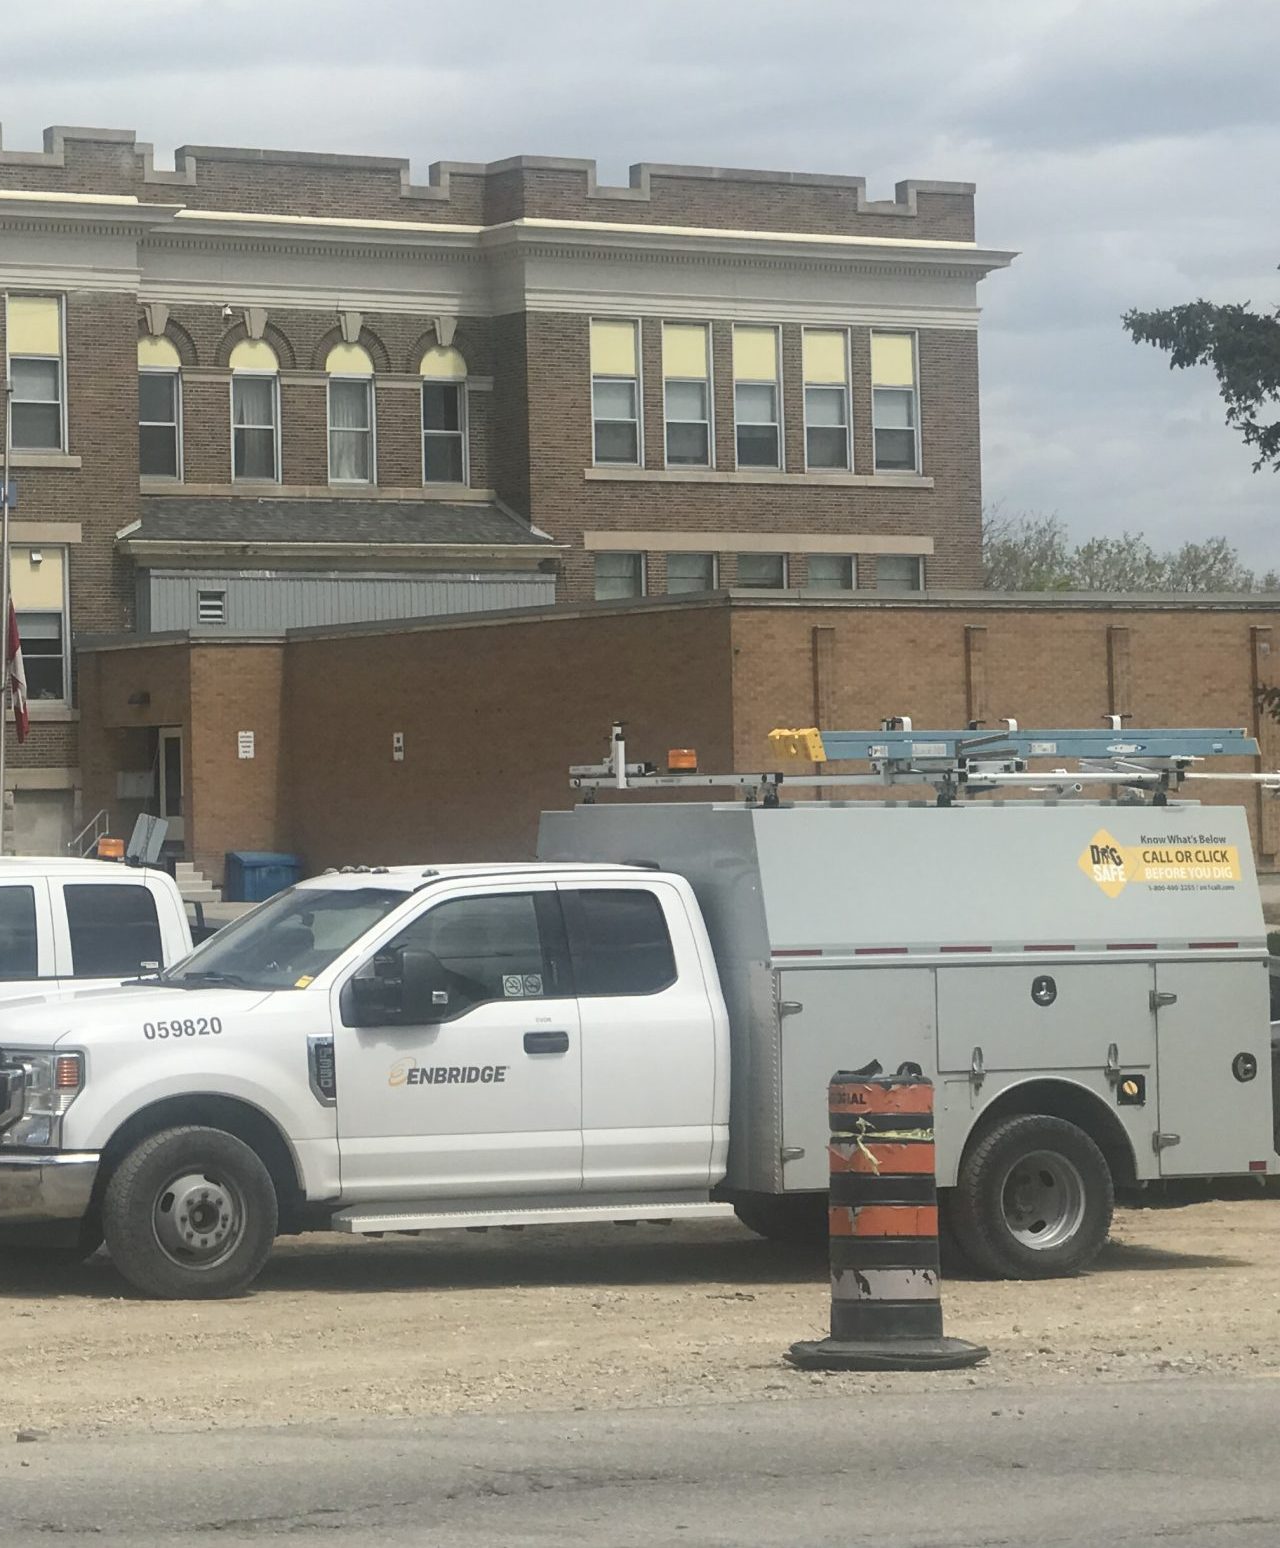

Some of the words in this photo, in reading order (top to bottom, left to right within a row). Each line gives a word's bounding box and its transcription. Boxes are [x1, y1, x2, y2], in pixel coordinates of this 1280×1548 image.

[1140, 834, 1166, 844] Know
[1167, 834, 1198, 844] What's
[1199, 834, 1226, 844] Below
[1142, 850, 1173, 863] CALL
[1175, 850, 1193, 863] OR
[1195, 850, 1229, 863] CLICK
[1092, 864, 1127, 882] SAFE
[1145, 867, 1187, 879] BEFORE
[1187, 867, 1212, 879] YOU
[1213, 867, 1233, 879] DIG
[142, 1016, 223, 1040] 059820
[406, 1065, 507, 1086] ENBRIDGE
